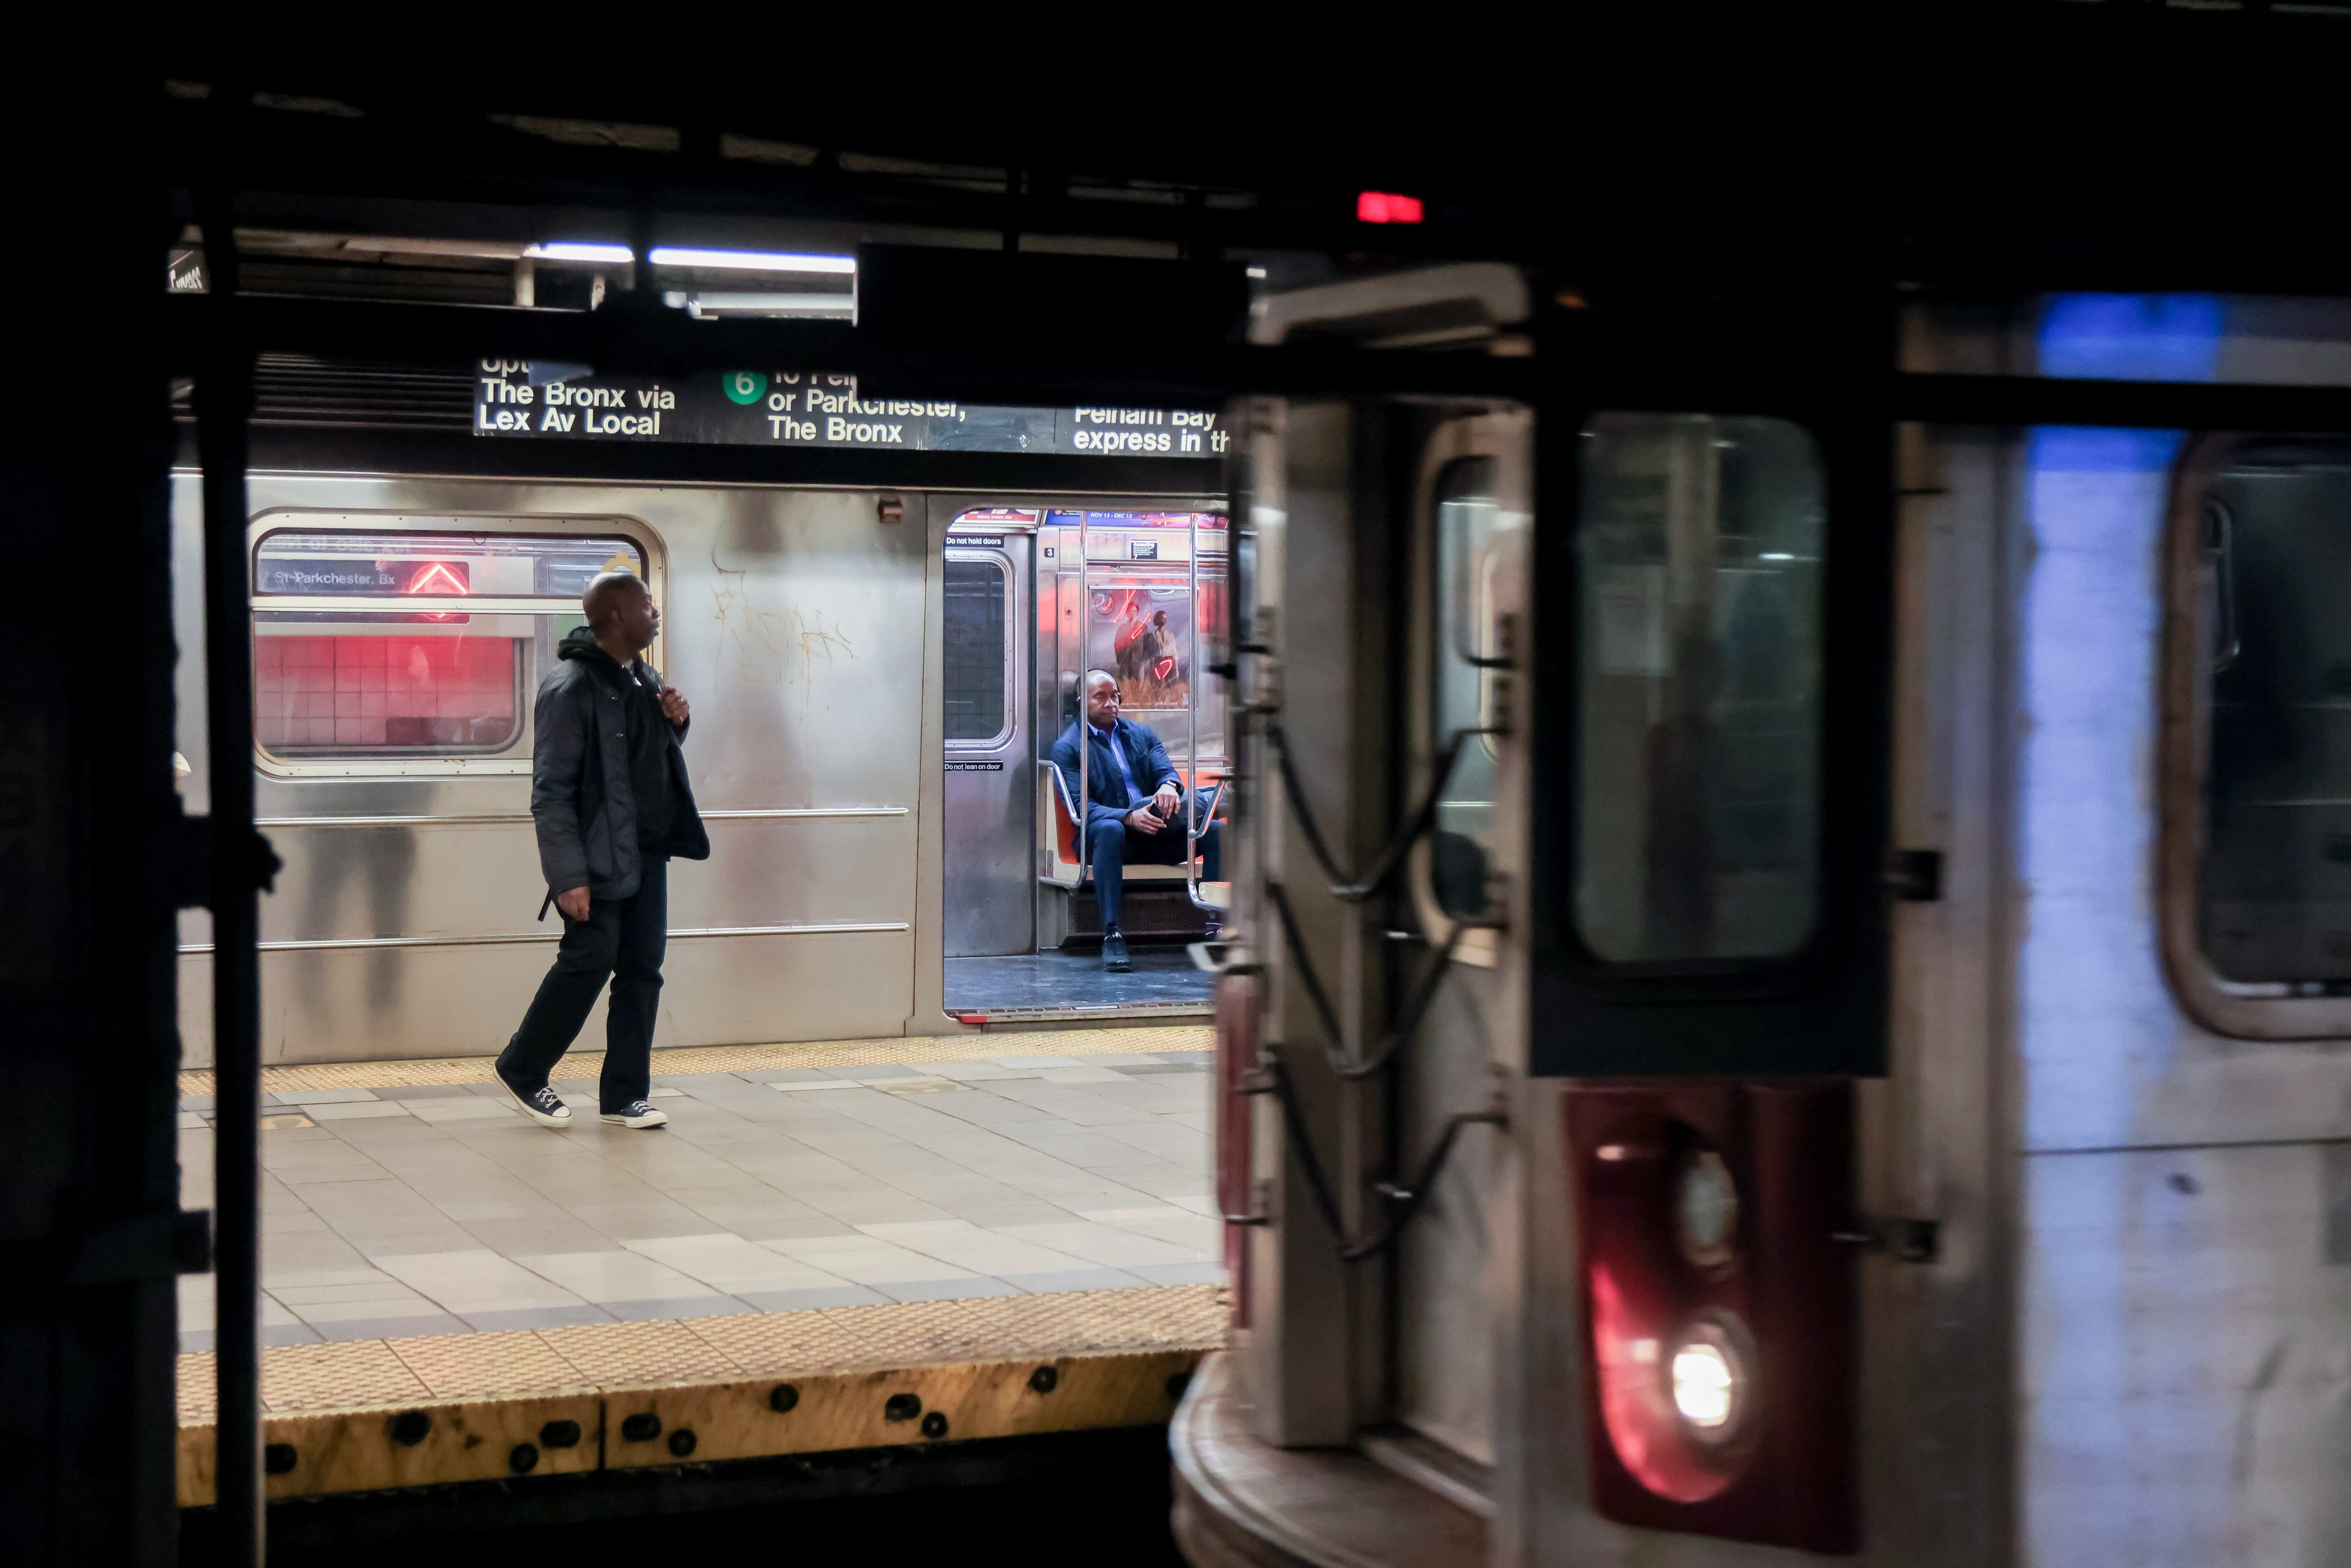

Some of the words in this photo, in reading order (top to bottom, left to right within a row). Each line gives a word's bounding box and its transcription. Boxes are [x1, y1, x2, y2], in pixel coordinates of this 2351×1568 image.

[481, 378, 534, 404] The
[546, 382, 625, 408] Bronx
[638, 386, 675, 410] via
[735, 372, 754, 394] 6
[769, 394, 796, 411] or
[480, 405, 530, 432] Lex
[542, 408, 576, 434] Av
[587, 409, 660, 435] Local
[768, 416, 816, 440] The
[828, 417, 902, 443] Bronx
[1074, 431, 1171, 454] express
[1181, 428, 1201, 452] in
[1047, 548, 1053, 557] 3
[379, 573, 396, 585] Bx
